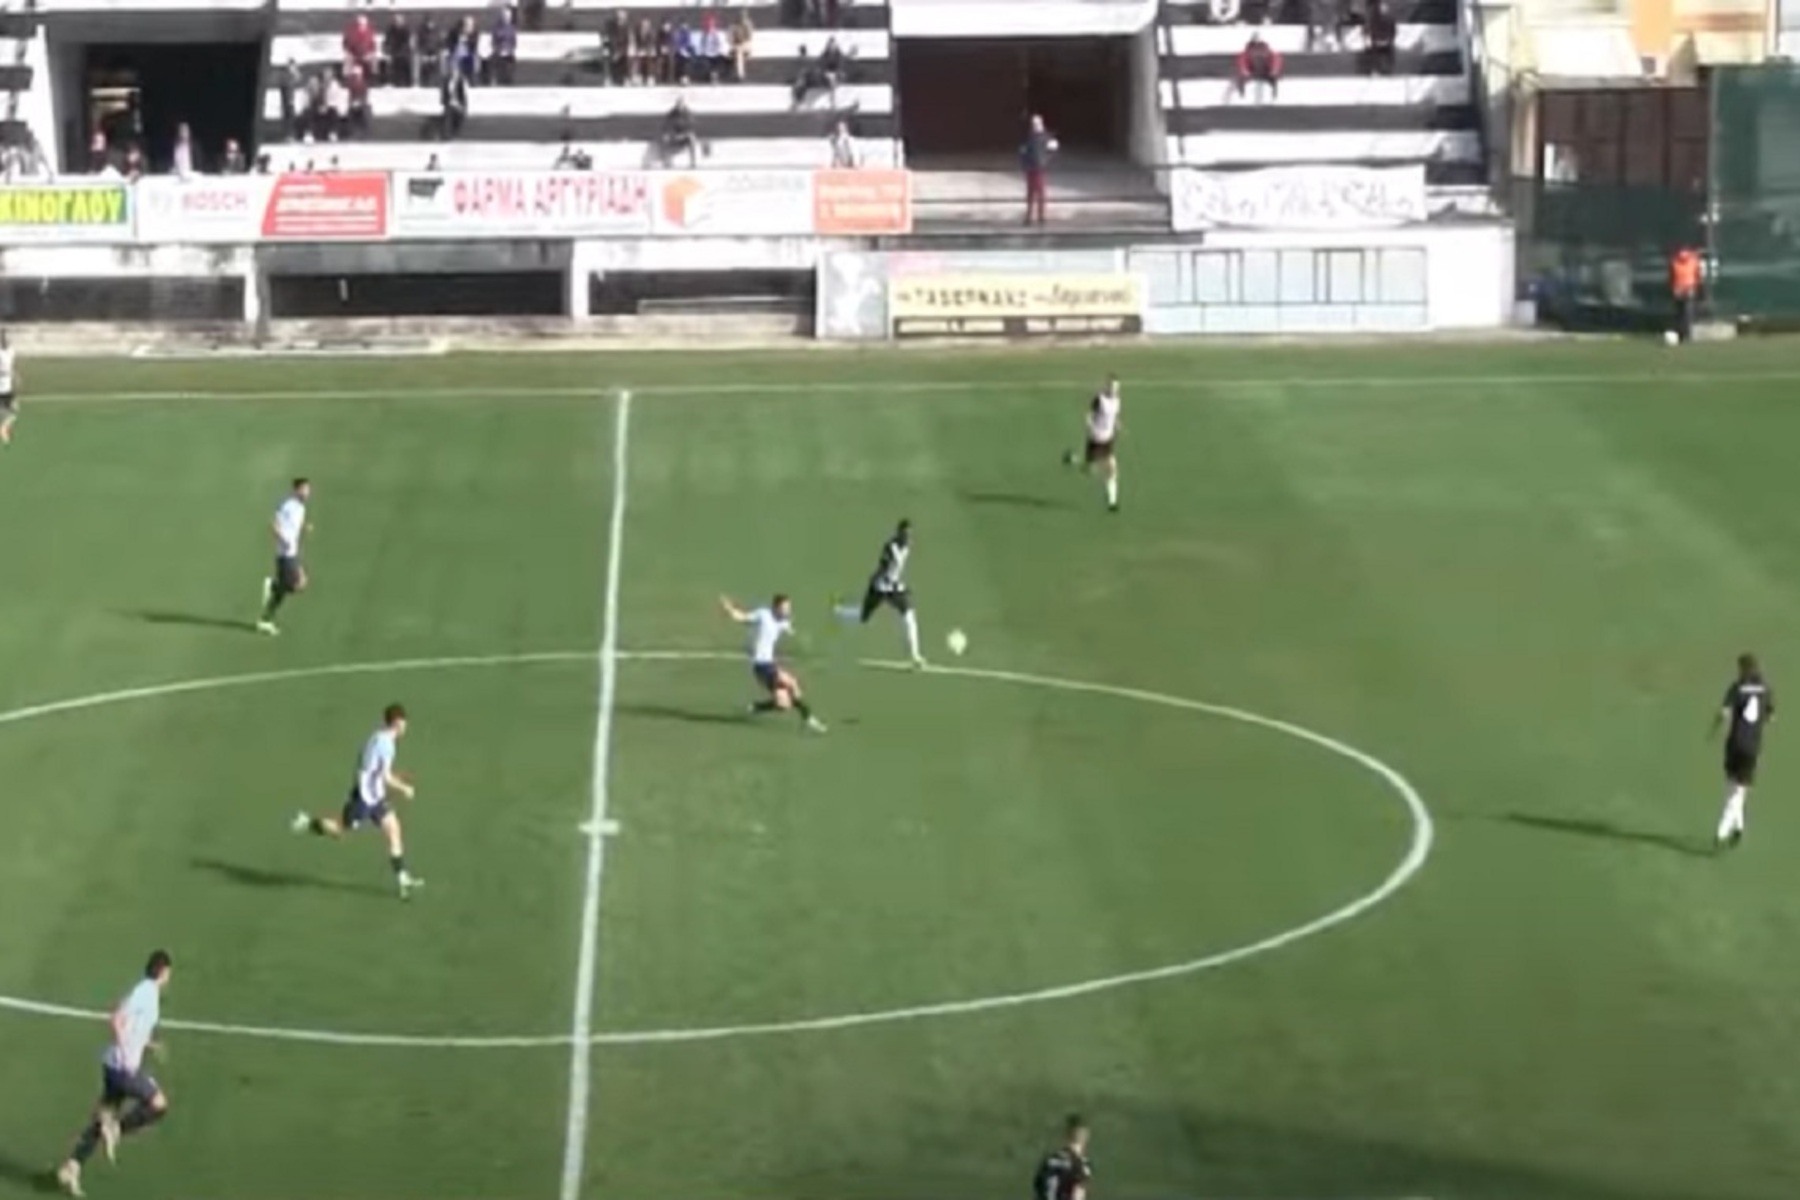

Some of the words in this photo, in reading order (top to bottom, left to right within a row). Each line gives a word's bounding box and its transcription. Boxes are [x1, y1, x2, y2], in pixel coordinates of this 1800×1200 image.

[182, 189, 248, 211] BOSCH
[453, 178, 527, 216] ΦΑΡΜΑ
[534, 176, 649, 216] ΑΡΓΥΡΙΑΔΗ
[1742, 693, 1759, 723] 4
